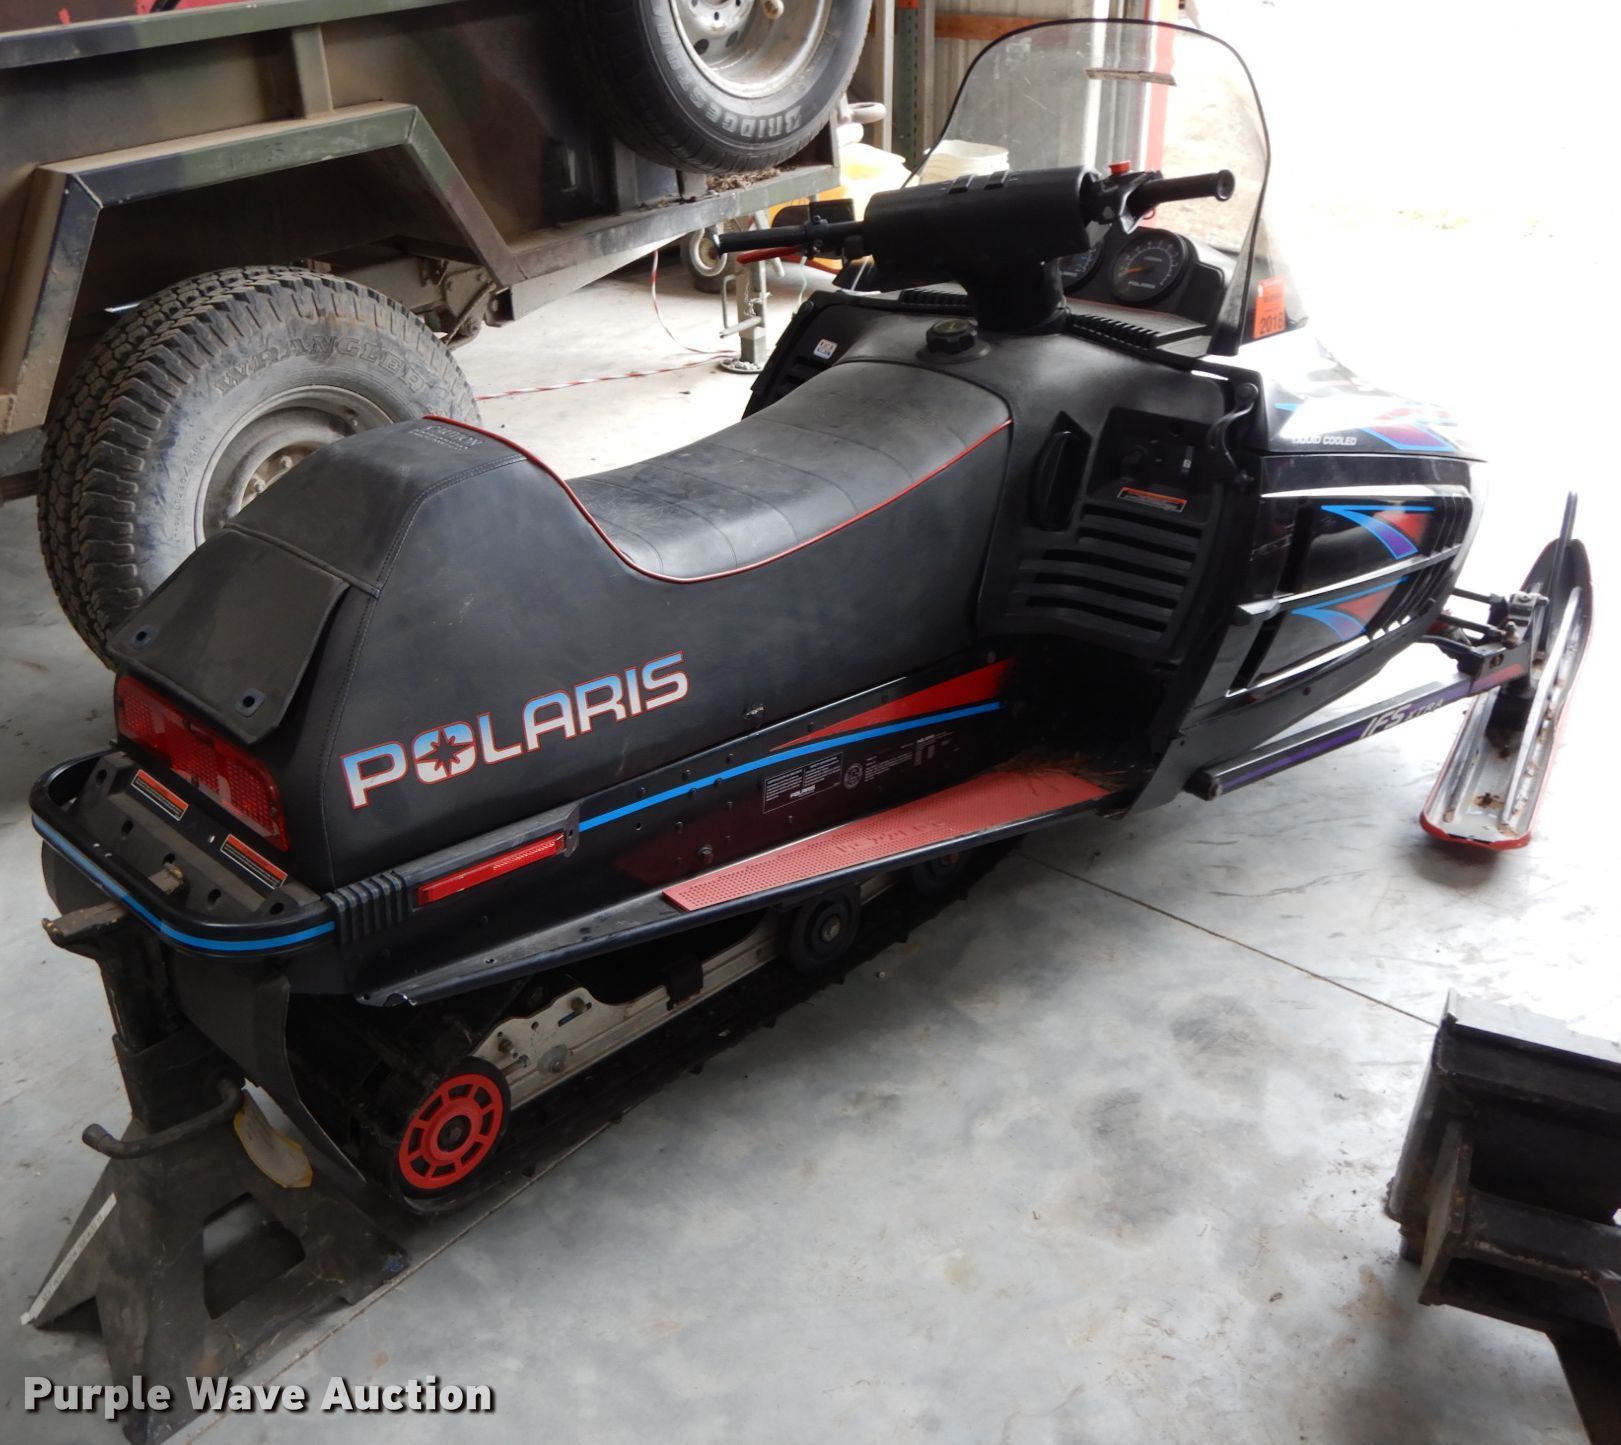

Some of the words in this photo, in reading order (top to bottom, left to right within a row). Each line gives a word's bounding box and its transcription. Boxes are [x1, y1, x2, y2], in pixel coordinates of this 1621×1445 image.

[213, 335, 425, 394] WRANGLER
[1322, 436, 1357, 446] COOLED
[340, 650, 689, 810] POLARIS
